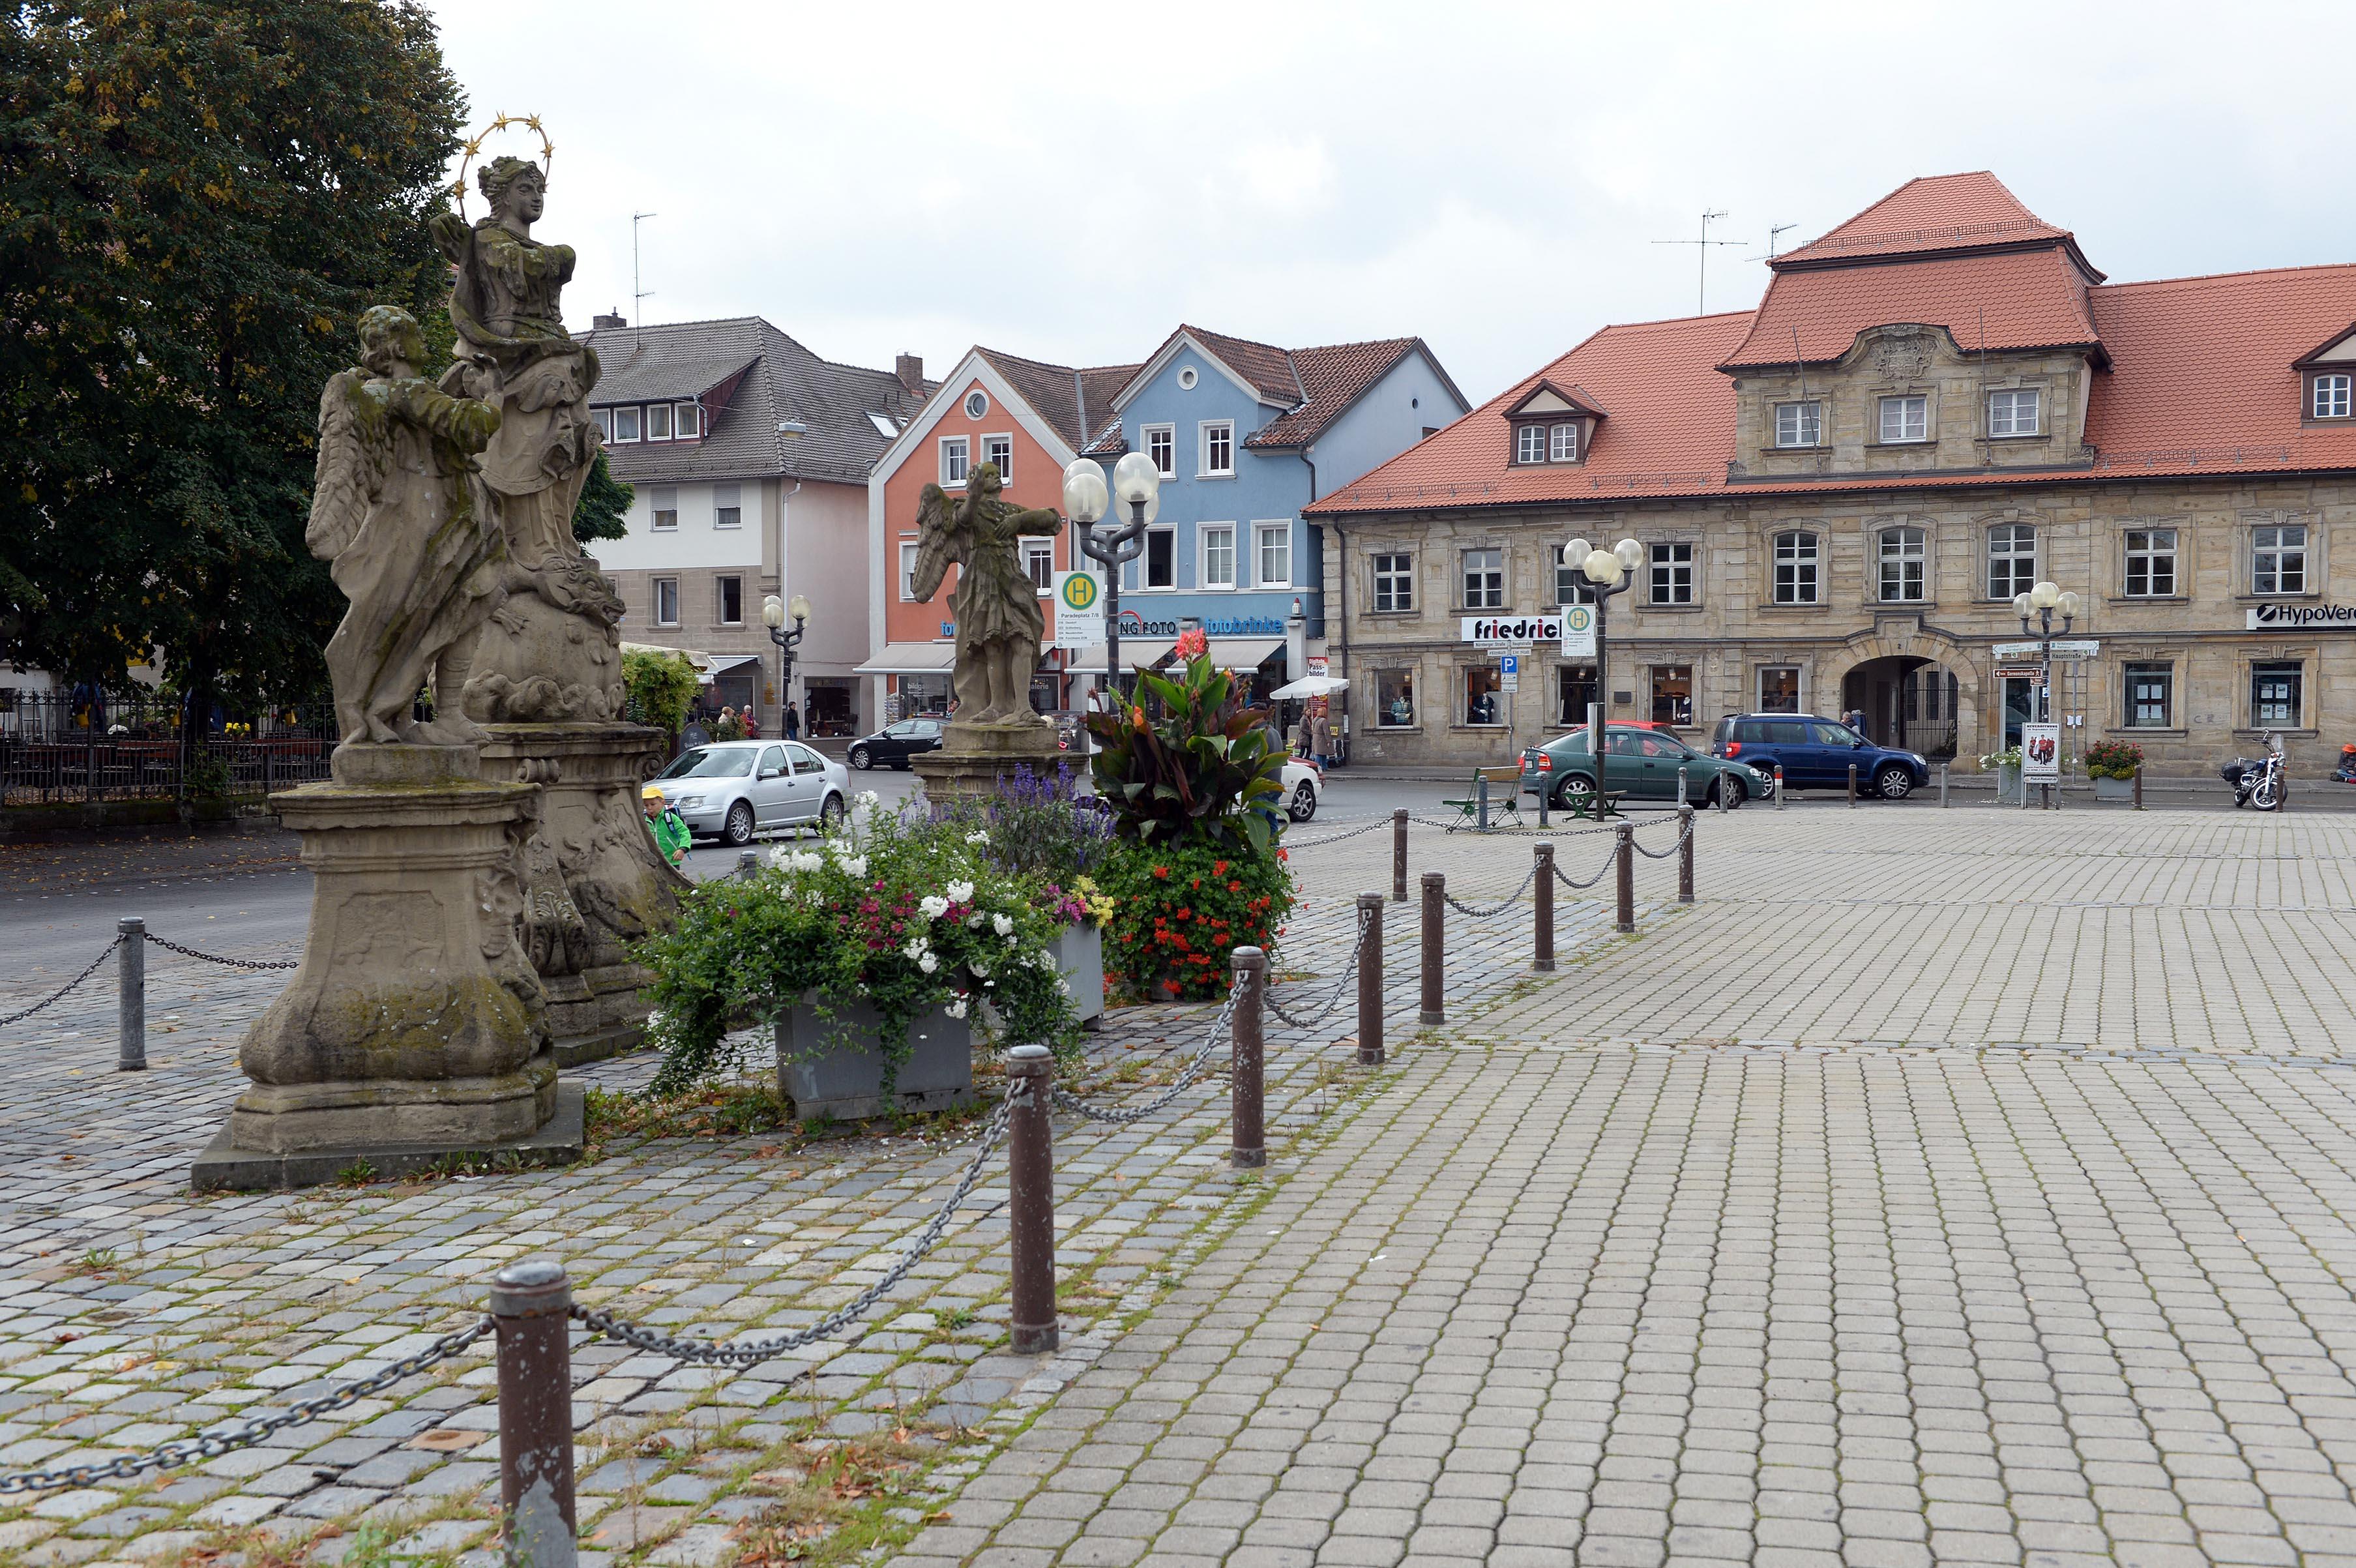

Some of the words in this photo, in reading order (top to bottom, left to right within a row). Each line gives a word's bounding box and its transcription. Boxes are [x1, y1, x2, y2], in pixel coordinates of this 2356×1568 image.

[1072, 581, 1087, 602] H
[1574, 612, 1583, 627] H
[2279, 604, 2356, 625] HypoVer
[1143, 621, 1176, 634] FOTO
[1205, 616, 1284, 634] fotobrinke
[1504, 658, 1514, 672] P
